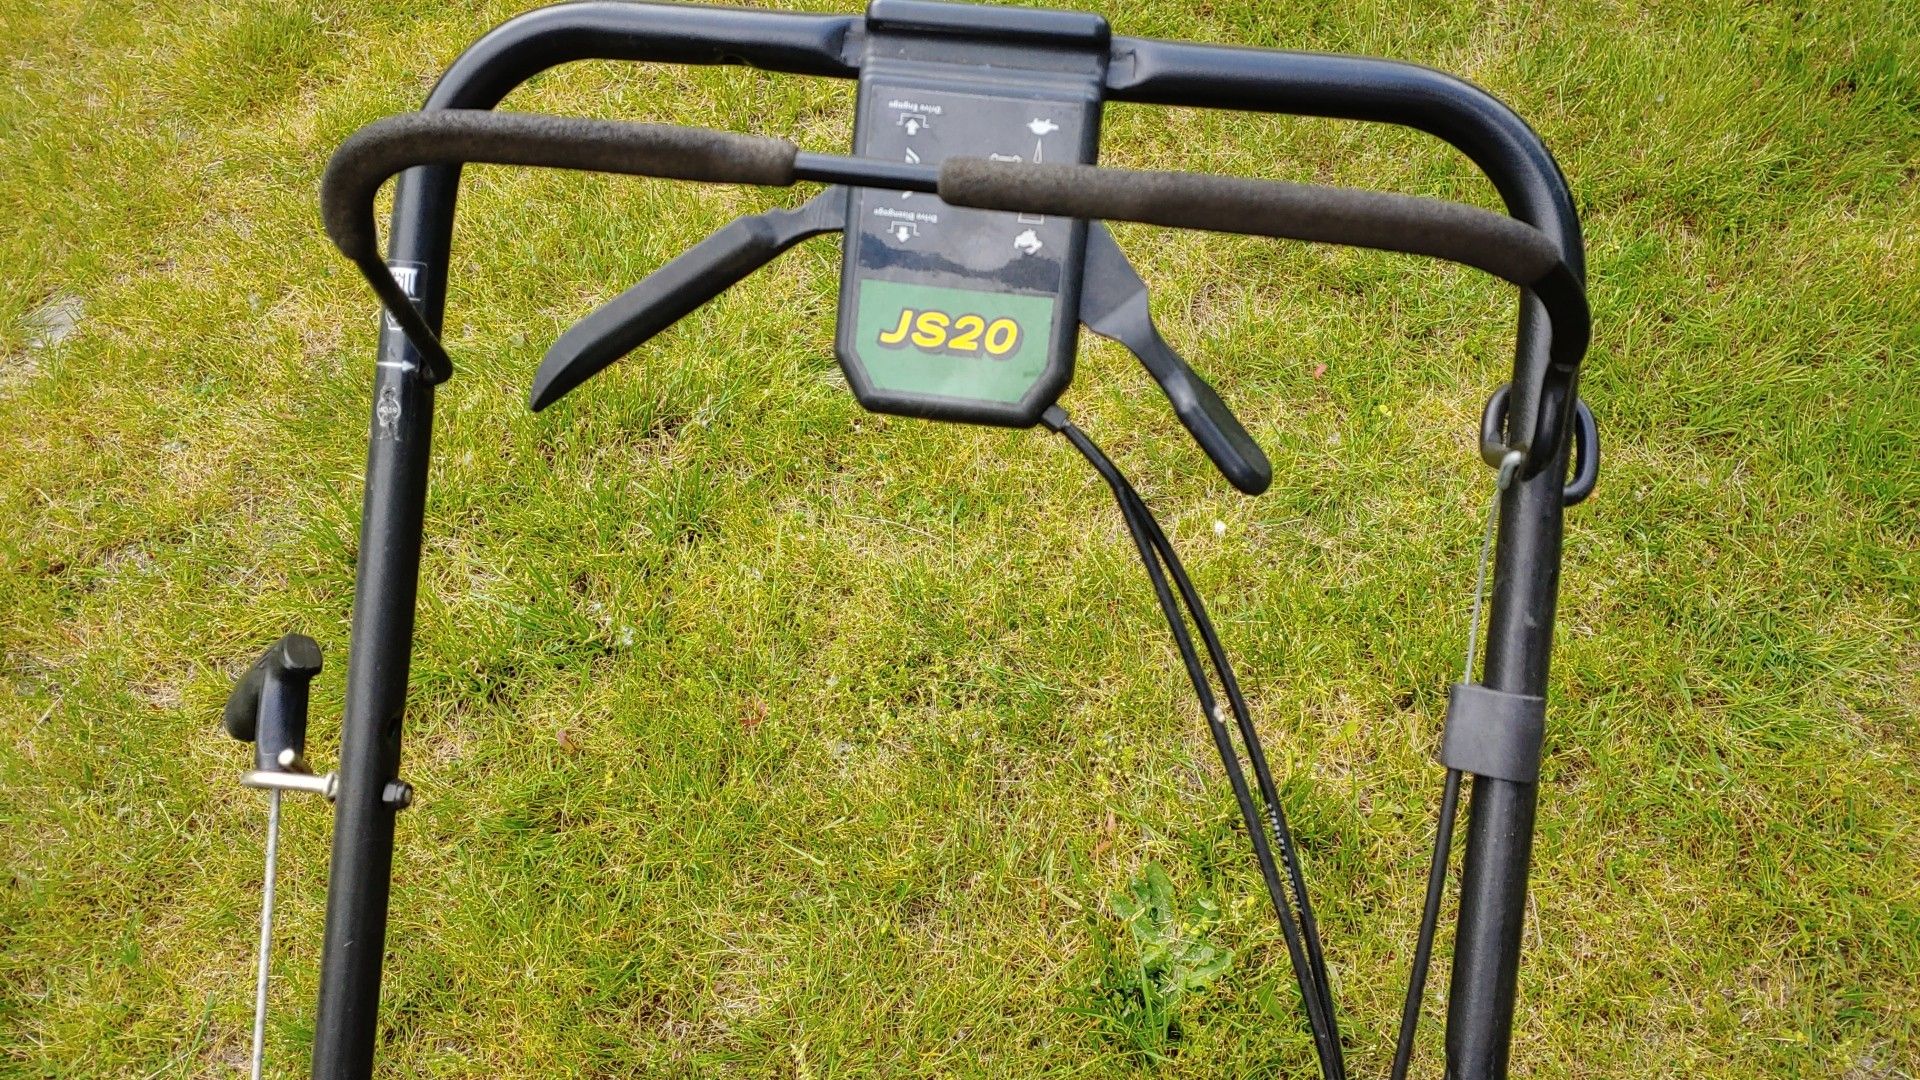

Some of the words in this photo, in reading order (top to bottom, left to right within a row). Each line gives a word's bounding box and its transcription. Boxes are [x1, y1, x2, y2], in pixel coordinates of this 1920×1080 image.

[888, 99, 918, 111] Engage
[920, 104, 942, 115] Drive
[873, 207, 915, 221] Disengage
[916, 213, 938, 224] Drive
[879, 308, 1021, 358] JS20
